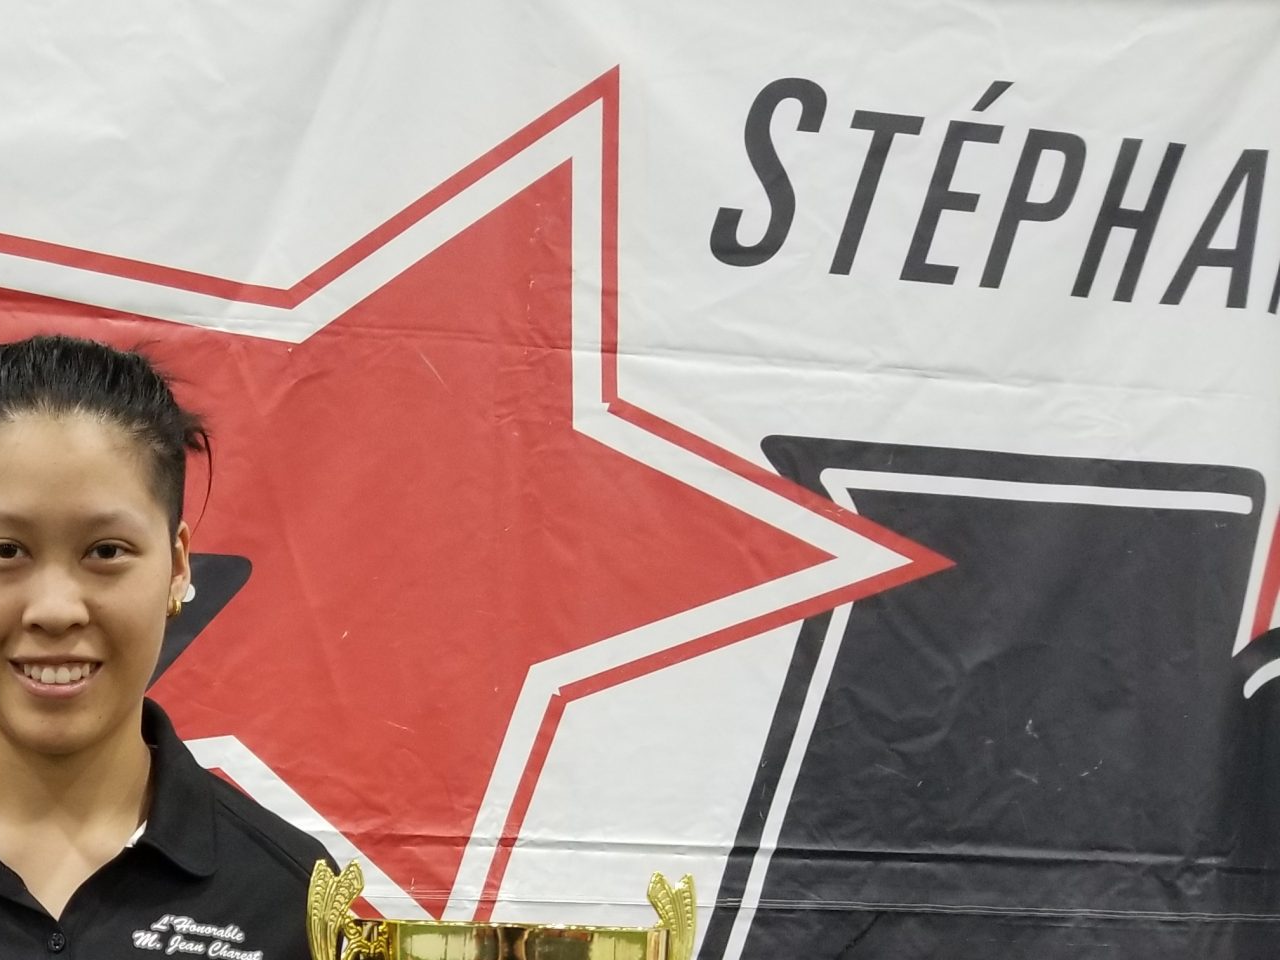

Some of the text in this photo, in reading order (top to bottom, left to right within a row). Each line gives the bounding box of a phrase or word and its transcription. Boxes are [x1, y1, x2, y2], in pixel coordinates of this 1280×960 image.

[710, 77, 1280, 315] STÉPHA
[133, 931, 162, 949] M.
[166, 934, 205, 954] Jean
[151, 914, 245, 943] L'Honorable
